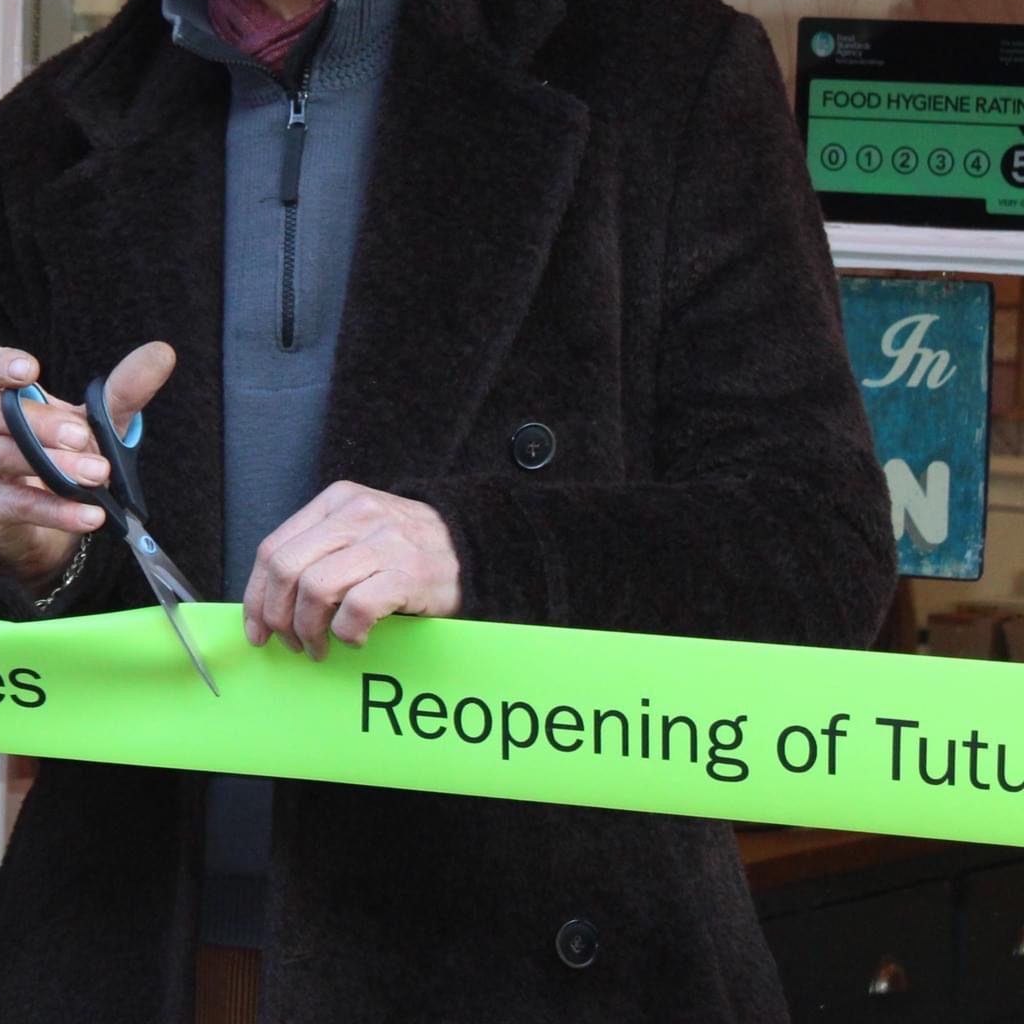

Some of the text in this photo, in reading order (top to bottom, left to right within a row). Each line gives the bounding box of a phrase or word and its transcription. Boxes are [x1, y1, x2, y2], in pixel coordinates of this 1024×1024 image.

[822, 90, 881, 109] FOOD
[887, 93, 971, 113] HYGIENE
[861, 313, 957, 389] In
[361, 672, 1024, 793] Reopening of Tutu
